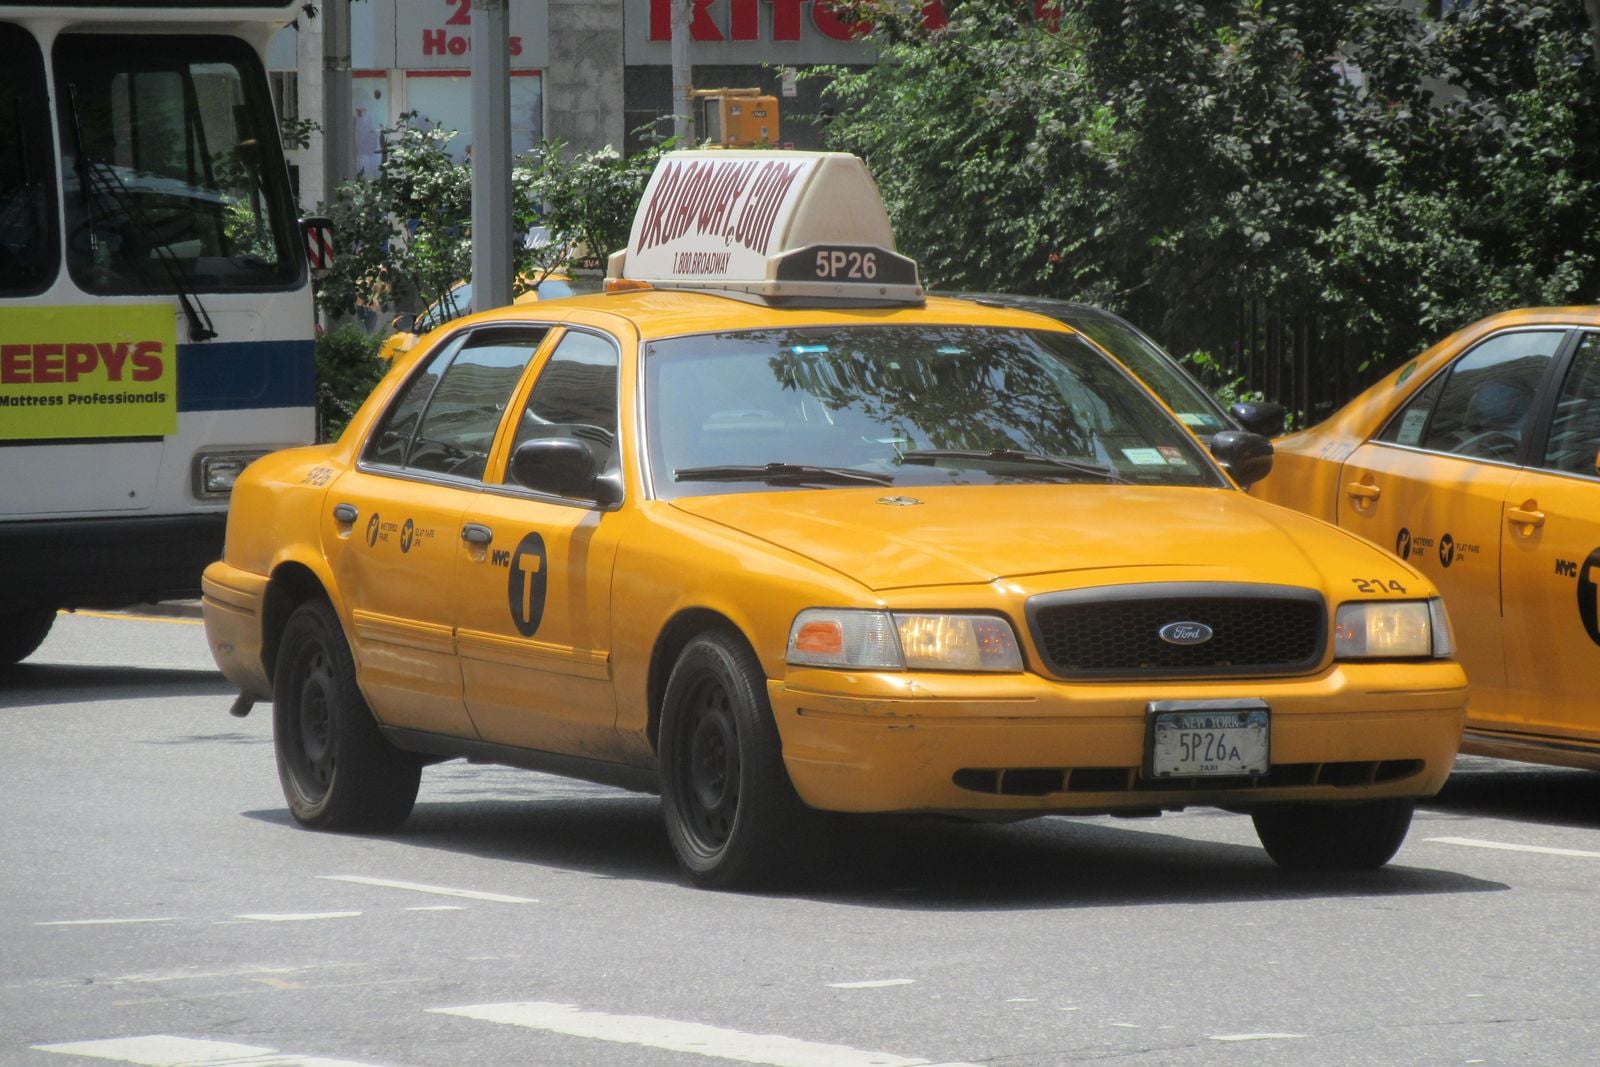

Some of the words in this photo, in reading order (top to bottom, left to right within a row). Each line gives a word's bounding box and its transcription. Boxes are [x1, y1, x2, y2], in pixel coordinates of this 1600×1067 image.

[423, 29, 522, 56] Hos
[815, 250, 877, 279] 5P26
[0, 394, 64, 407] Mattress
[67, 391, 166, 406] Professionals
[491, 549, 511, 568] NYC
[1555, 558, 1577, 578] NYC
[519, 553, 540, 623] T
[1352, 578, 1407, 594] 214
[1173, 625, 1201, 639] Ford
[1182, 717, 1206, 729] NEW
[1211, 715, 1239, 729] YORK
[1180, 732, 1241, 762] 5P26A
